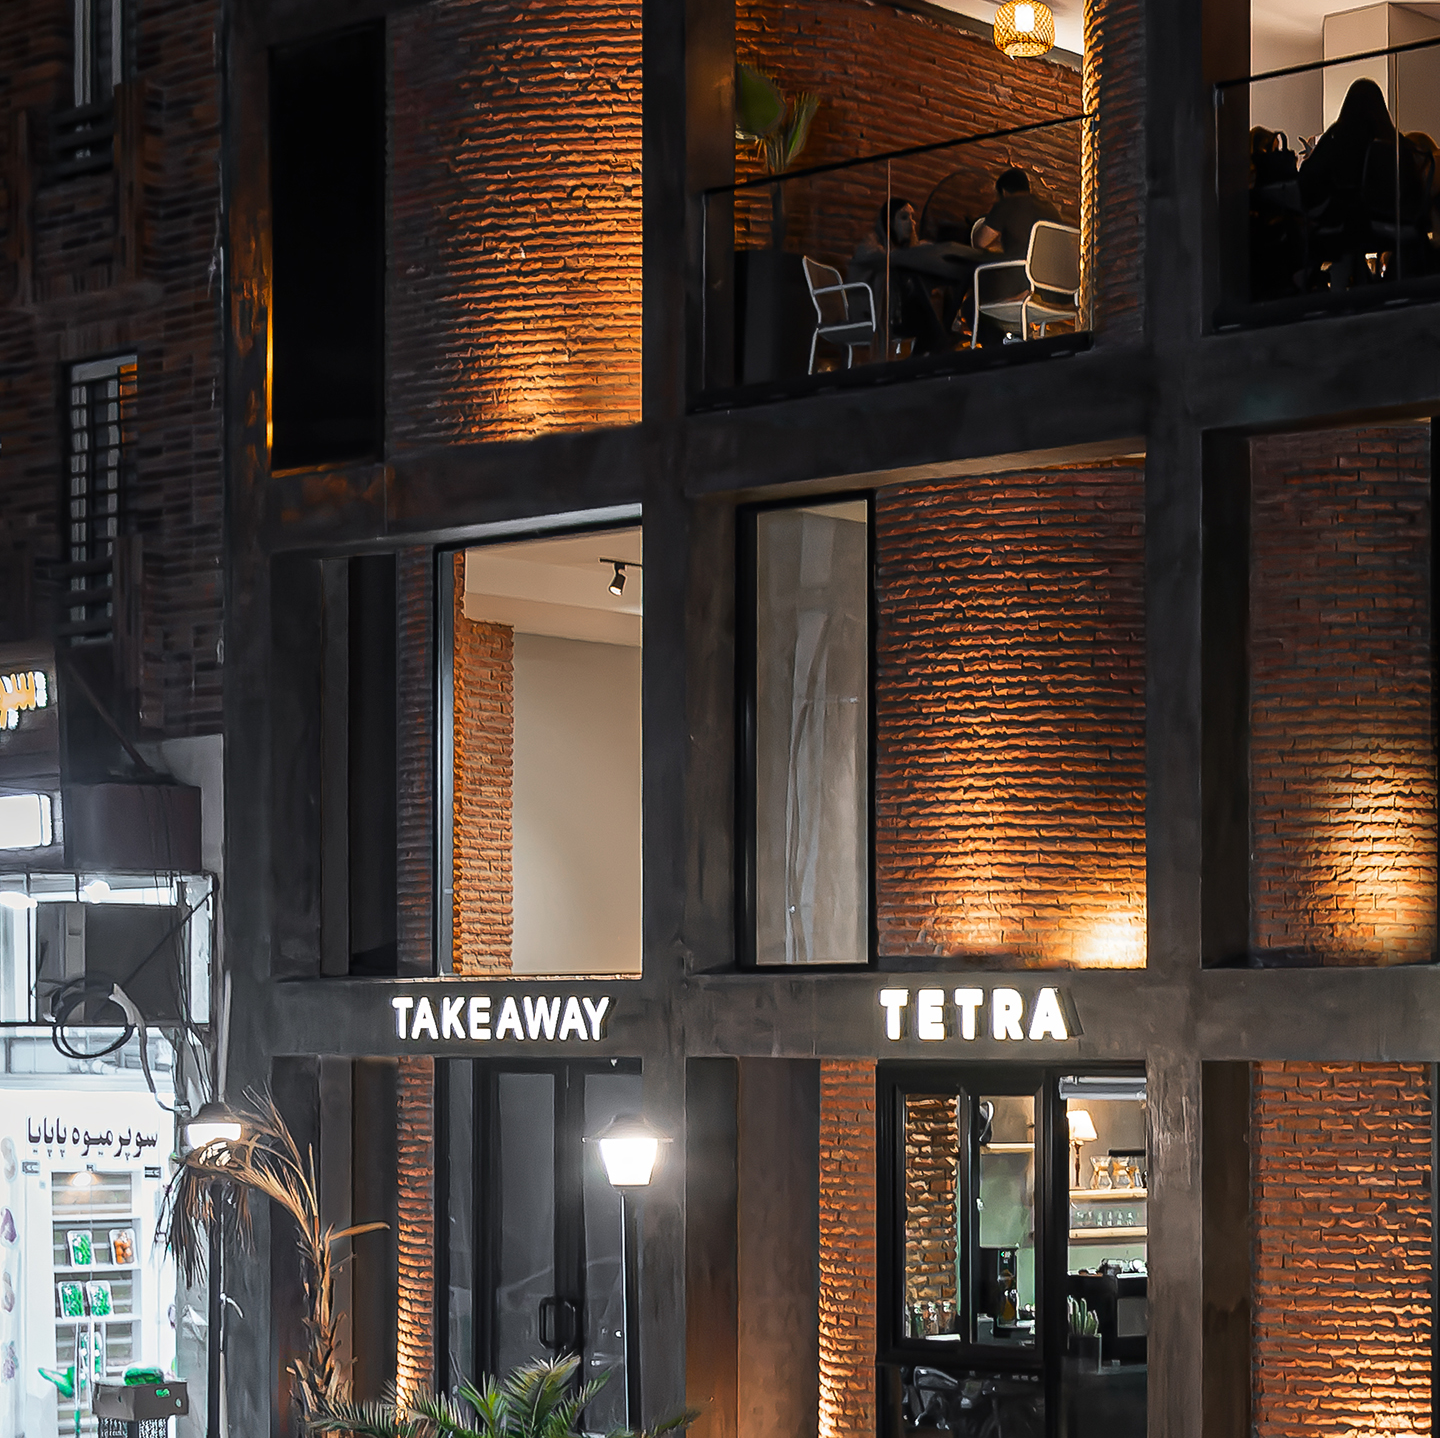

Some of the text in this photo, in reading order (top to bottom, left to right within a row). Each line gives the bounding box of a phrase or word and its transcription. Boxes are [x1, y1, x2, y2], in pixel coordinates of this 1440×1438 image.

[390, 995, 610, 1041] TAKEAWAY
[879, 986, 1070, 1040] TETRA
[27, 1117, 158, 1161] سوپر میوه پاپایا
